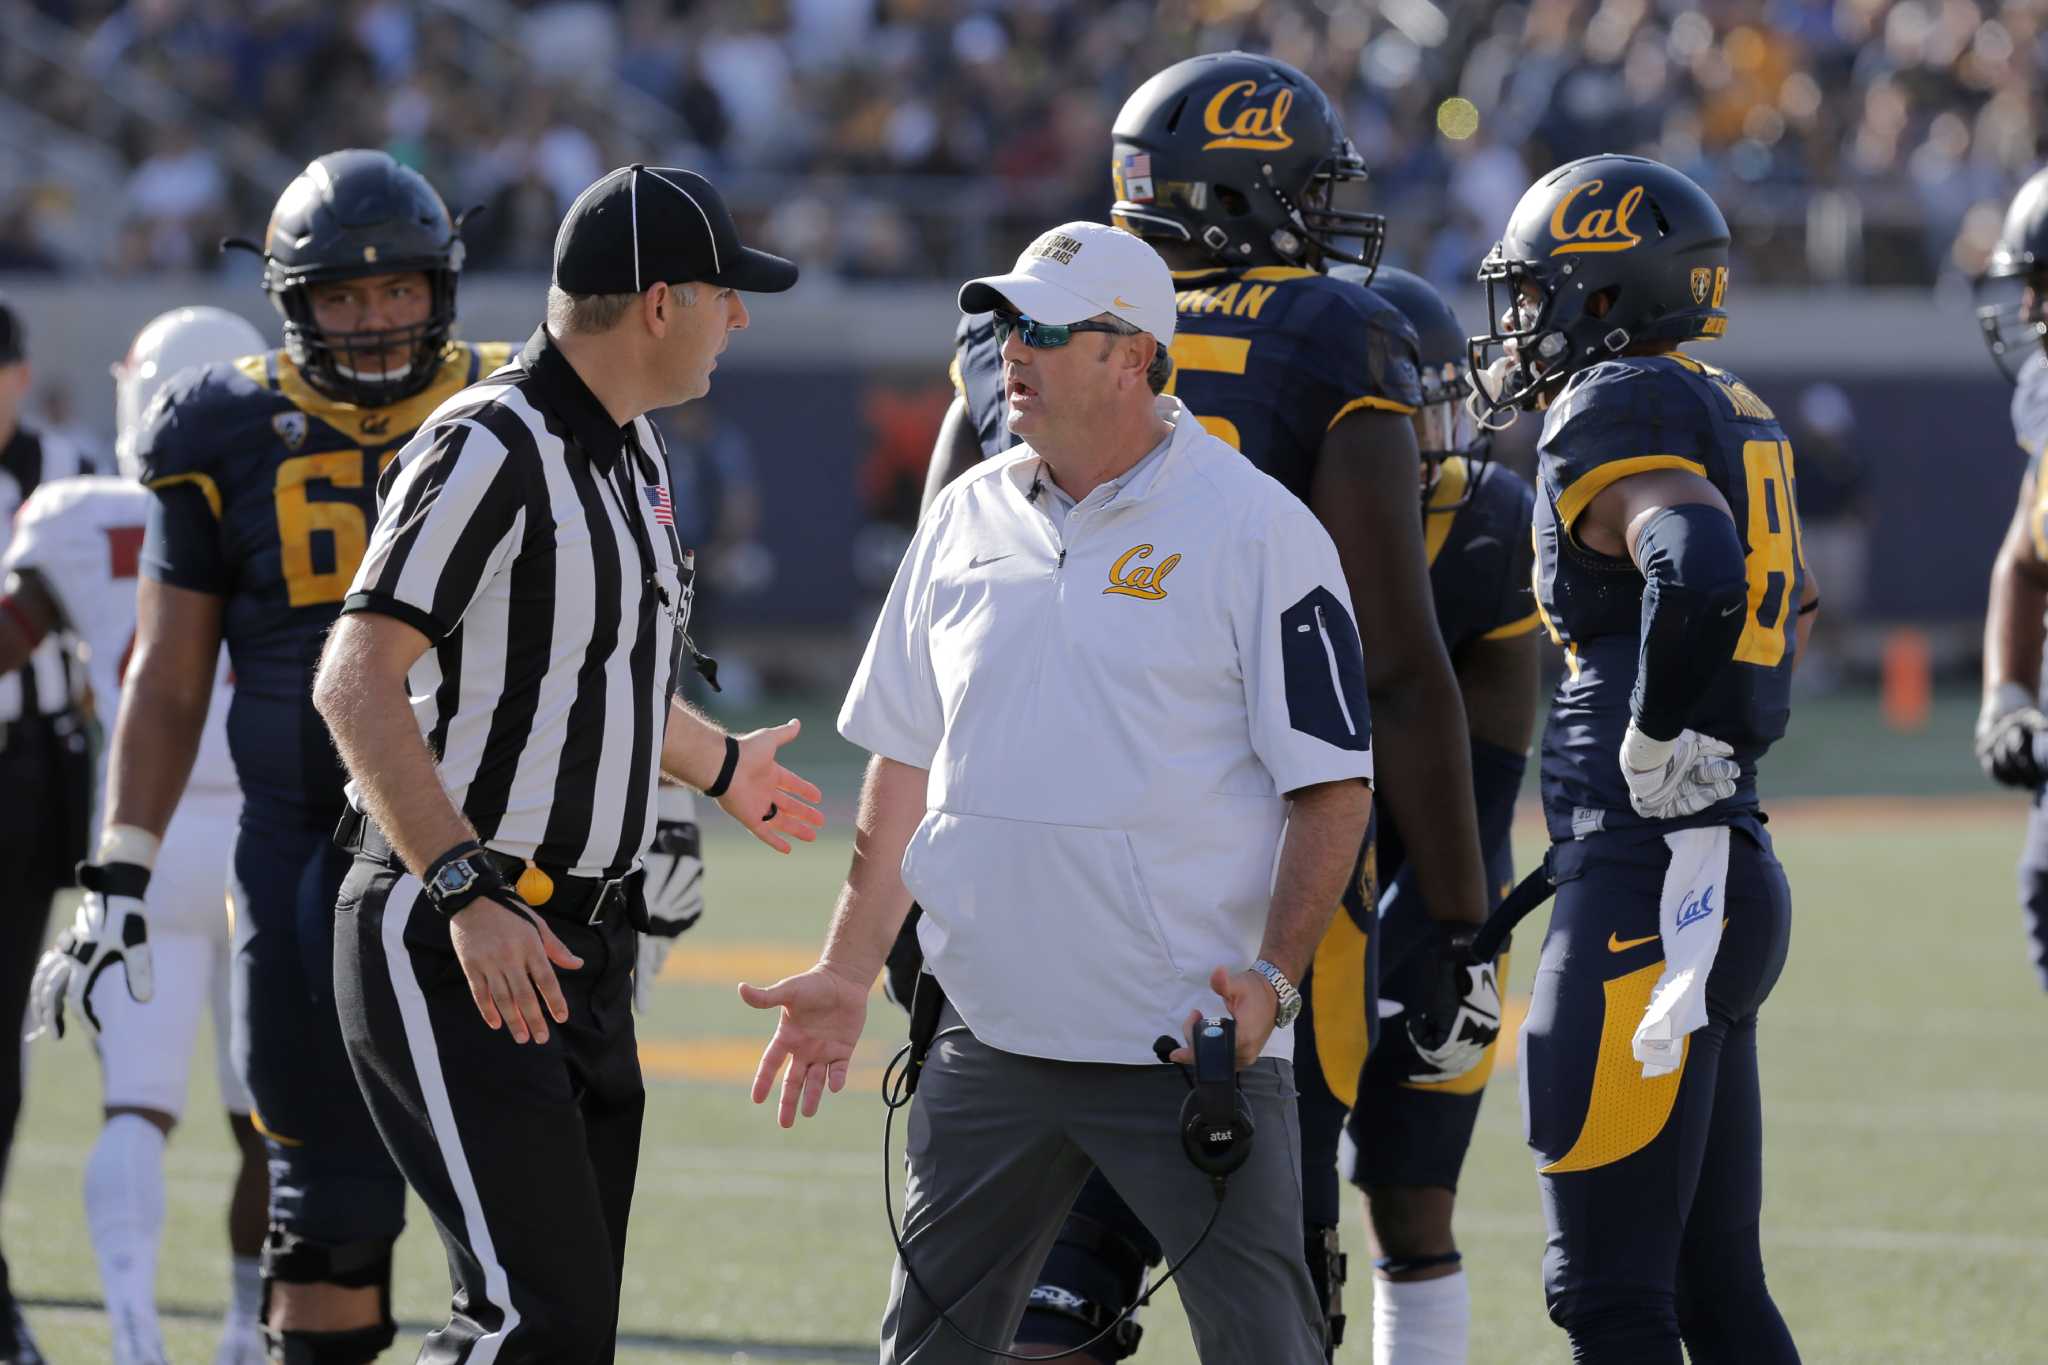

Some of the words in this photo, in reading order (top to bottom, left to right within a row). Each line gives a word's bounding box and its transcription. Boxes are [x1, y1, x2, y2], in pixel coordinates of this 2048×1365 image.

[1202, 79, 1294, 151] Cal
[1550, 178, 1645, 257] Cal
[274, 450, 398, 608] 6
[1102, 543, 1182, 600] Cal
[1675, 884, 1713, 936] Cal
